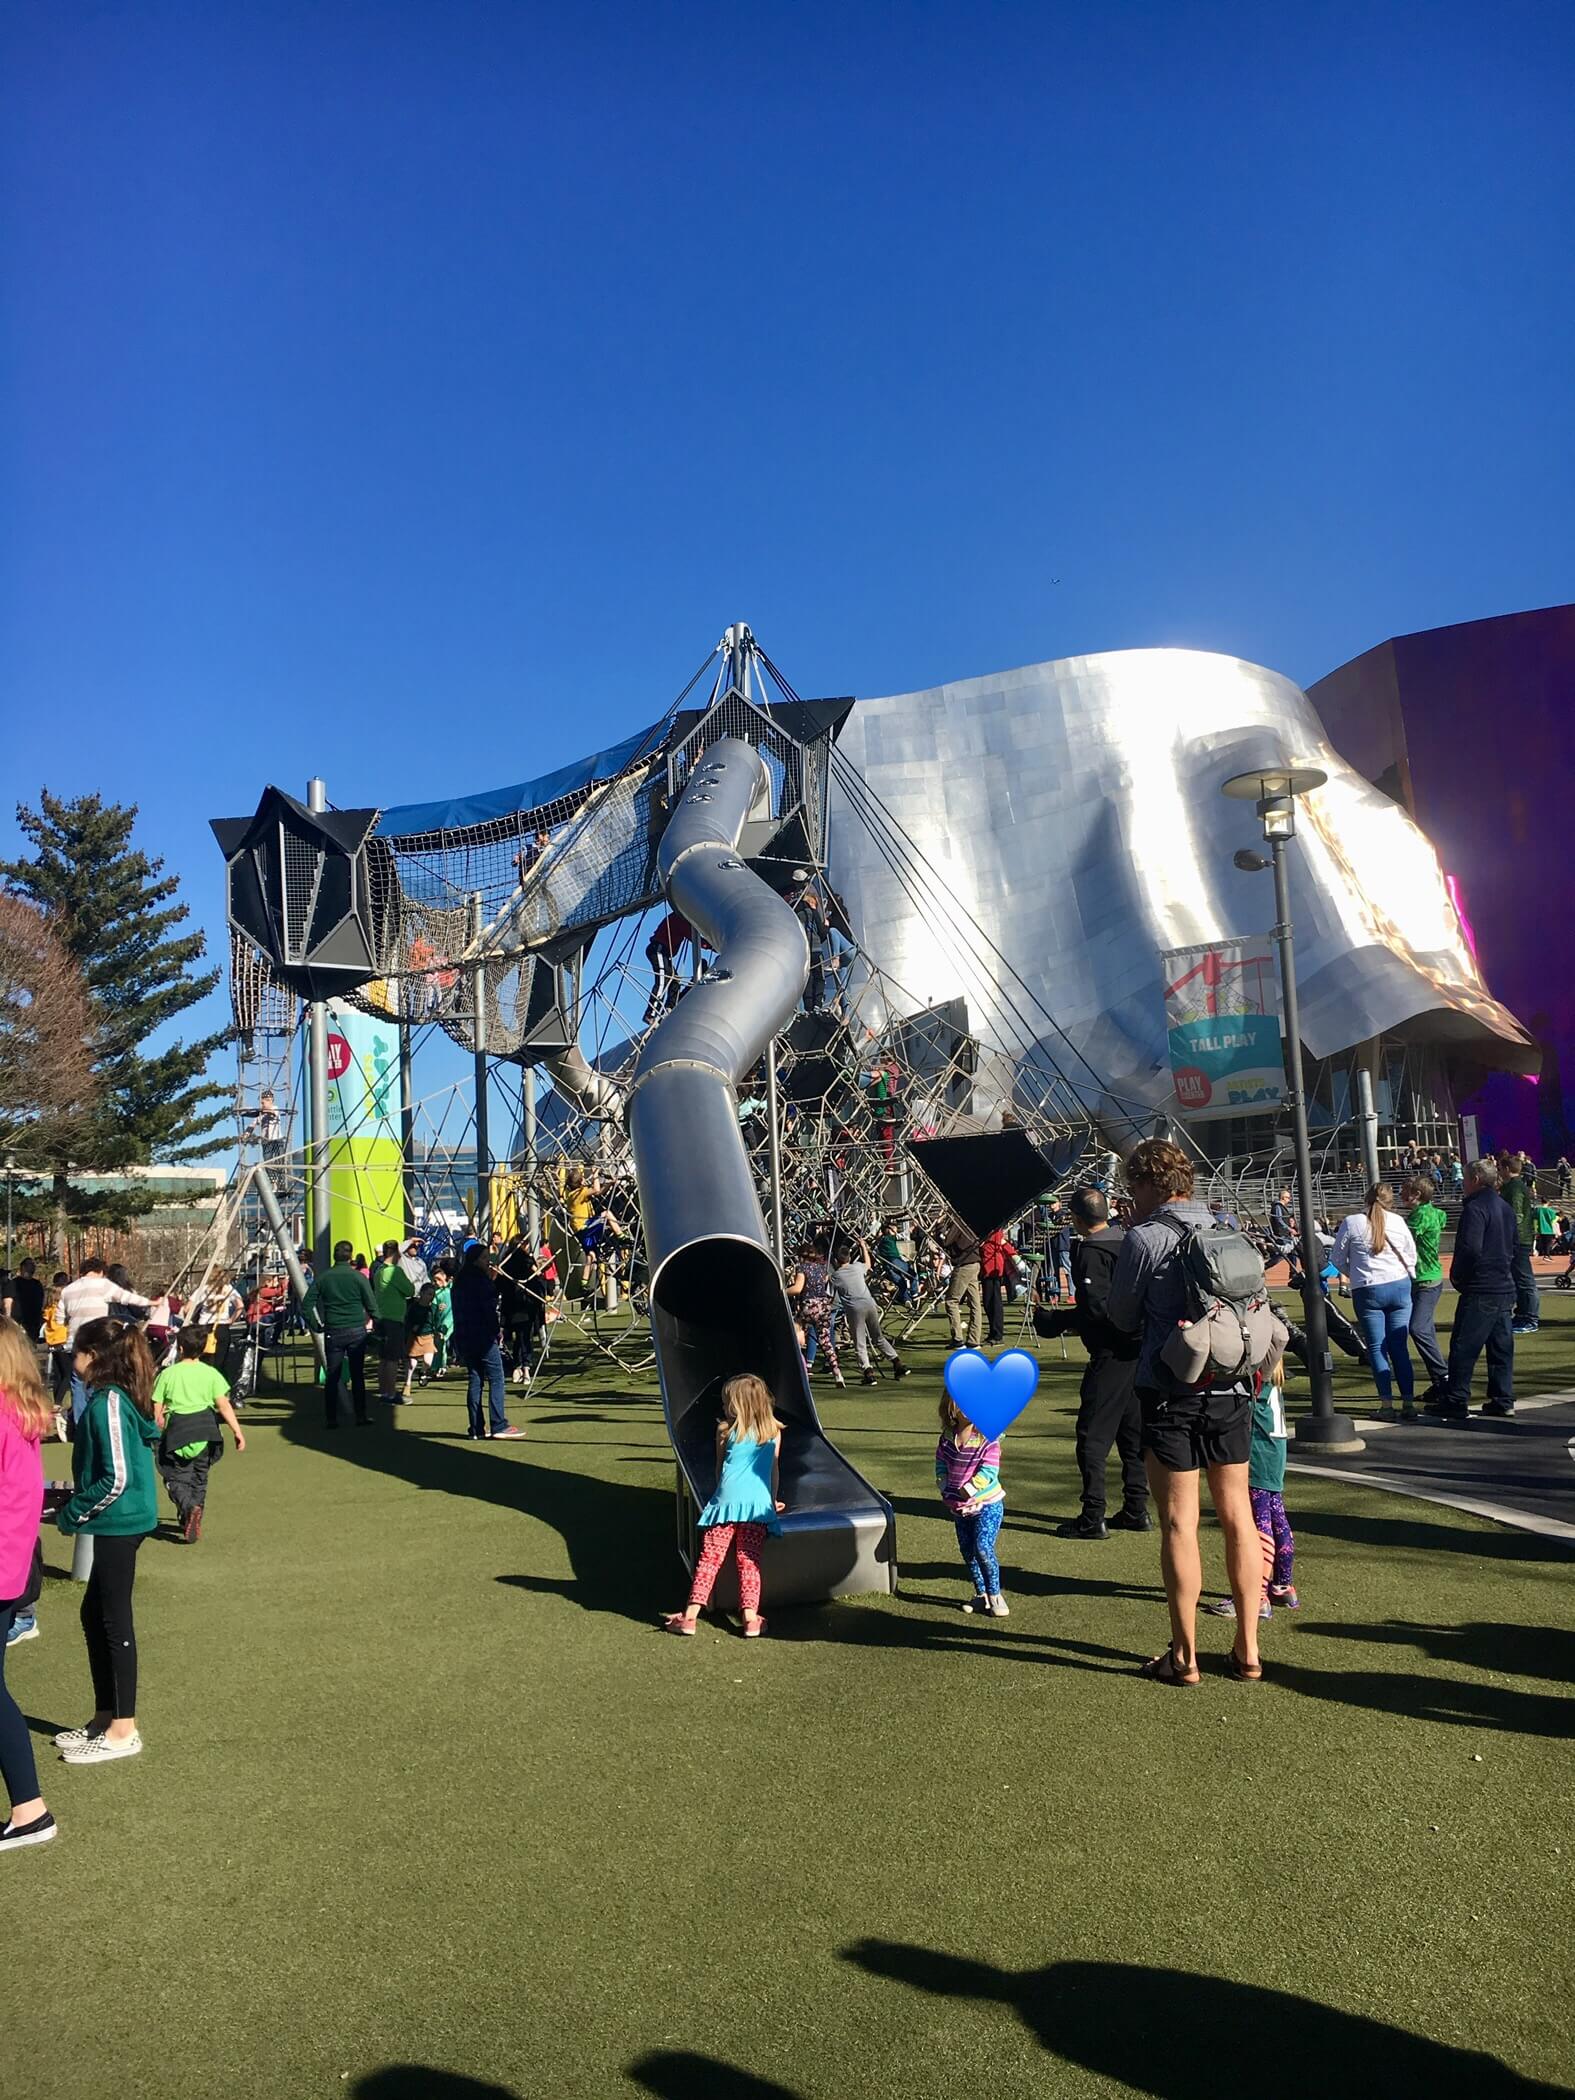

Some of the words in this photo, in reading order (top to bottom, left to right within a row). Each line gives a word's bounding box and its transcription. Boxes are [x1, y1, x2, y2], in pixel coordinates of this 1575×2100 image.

[1189, 1036, 1222, 1053] TALL
[1223, 1032, 1256, 1049] PLAY
[1177, 1075, 1202, 1092] PLAY
[1228, 1087, 1280, 1104] PLAY
